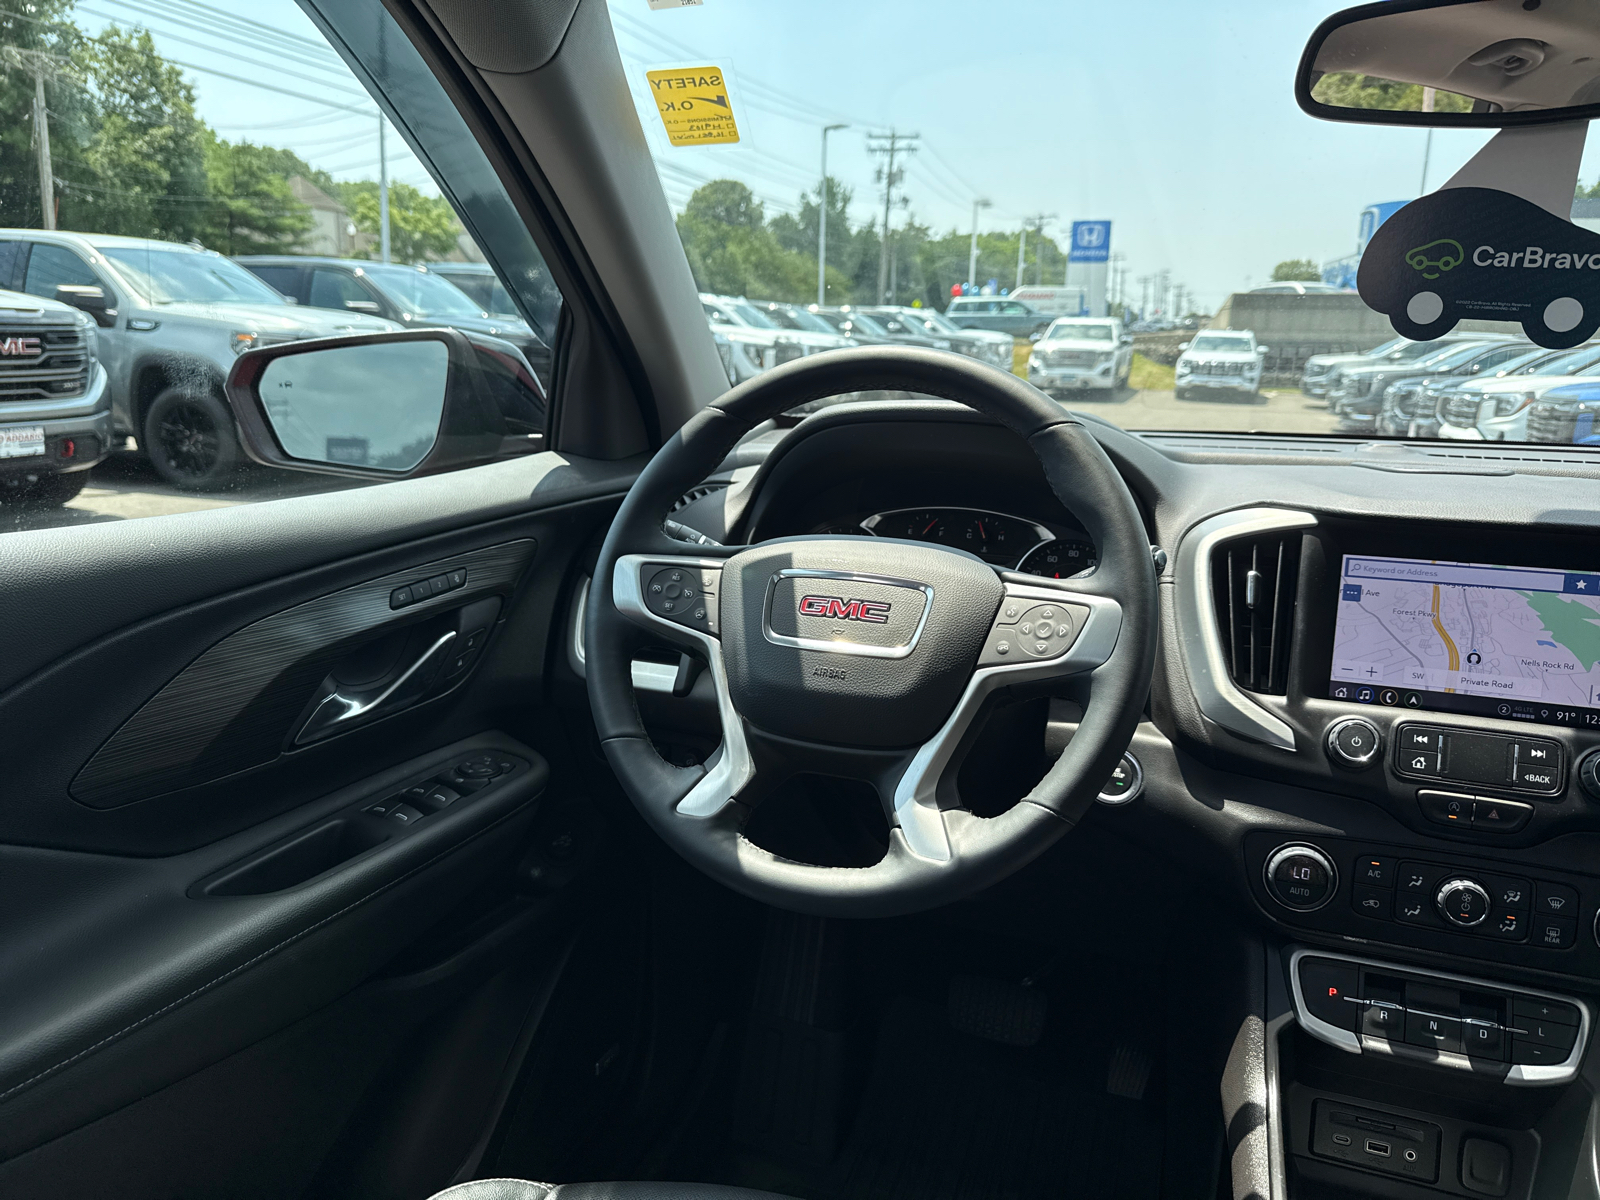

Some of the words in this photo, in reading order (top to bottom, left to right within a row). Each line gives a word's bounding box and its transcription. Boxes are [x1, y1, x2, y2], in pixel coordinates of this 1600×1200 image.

[1472, 245, 1600, 270] CarBravo
[1363, 566, 1396, 574] Keyword
[1407, 569, 1438, 577] Address
[800, 595, 891, 624] GMC
[1392, 608, 1416, 616] Forest
[1418, 610, 1436, 619] Pkwy
[1521, 659, 1541, 667] Nells
[1542, 661, 1562, 669] Rock
[1564, 662, 1575, 670] Rd
[812, 666, 847, 680] AIRBAG
[1460, 677, 1489, 687] Private
[1492, 680, 1514, 689] Road
[1530, 774, 1550, 784] BACK
[1293, 866, 1310, 880] LO
[1368, 869, 1381, 878] A/C
[1290, 886, 1310, 896] AUTO
[1329, 987, 1338, 996] P
[1380, 1010, 1388, 1020] R
[1430, 1021, 1438, 1031] N
[1480, 1030, 1487, 1039] D
